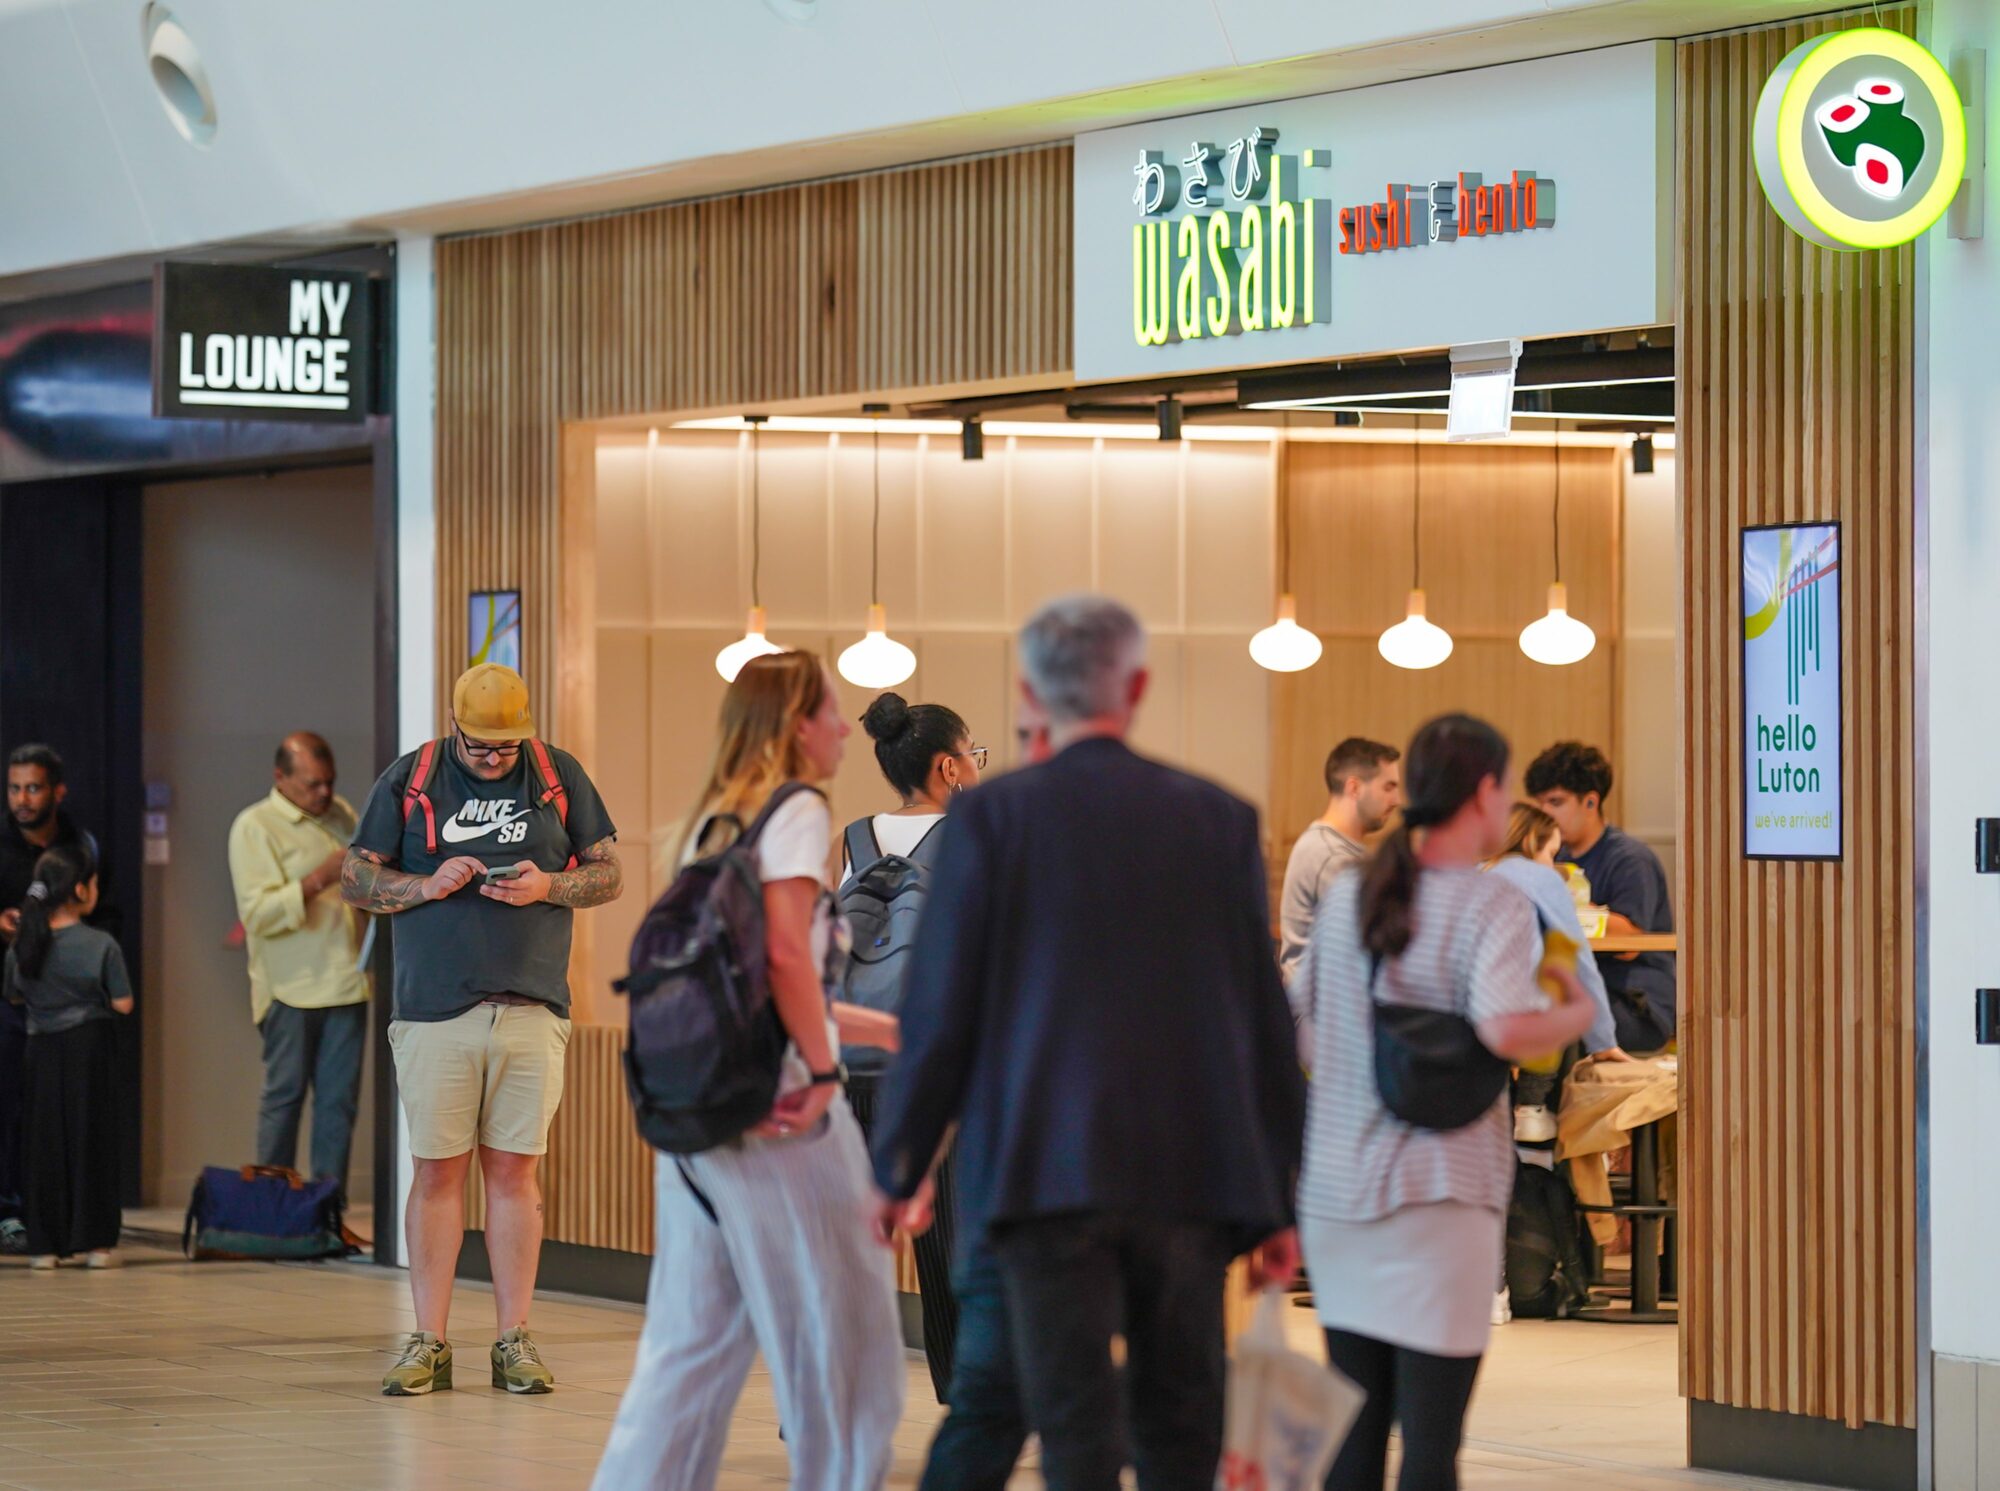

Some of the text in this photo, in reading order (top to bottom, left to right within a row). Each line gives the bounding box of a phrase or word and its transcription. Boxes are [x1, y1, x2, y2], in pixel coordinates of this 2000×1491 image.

[1132, 126, 1263, 217] わさび
[1339, 183, 1411, 255] sushi
[1458, 169, 1537, 237] bento
[1133, 149, 1315, 347] wasabi
[289, 279, 351, 336] MY
[179, 332, 351, 394] LOUNGE
[1757, 713, 1817, 752] hello
[1758, 757, 1820, 793] Luton
[457, 798, 517, 823] NIKE
[497, 820, 528, 844] SB
[1754, 810, 1833, 829] we've arrived!
